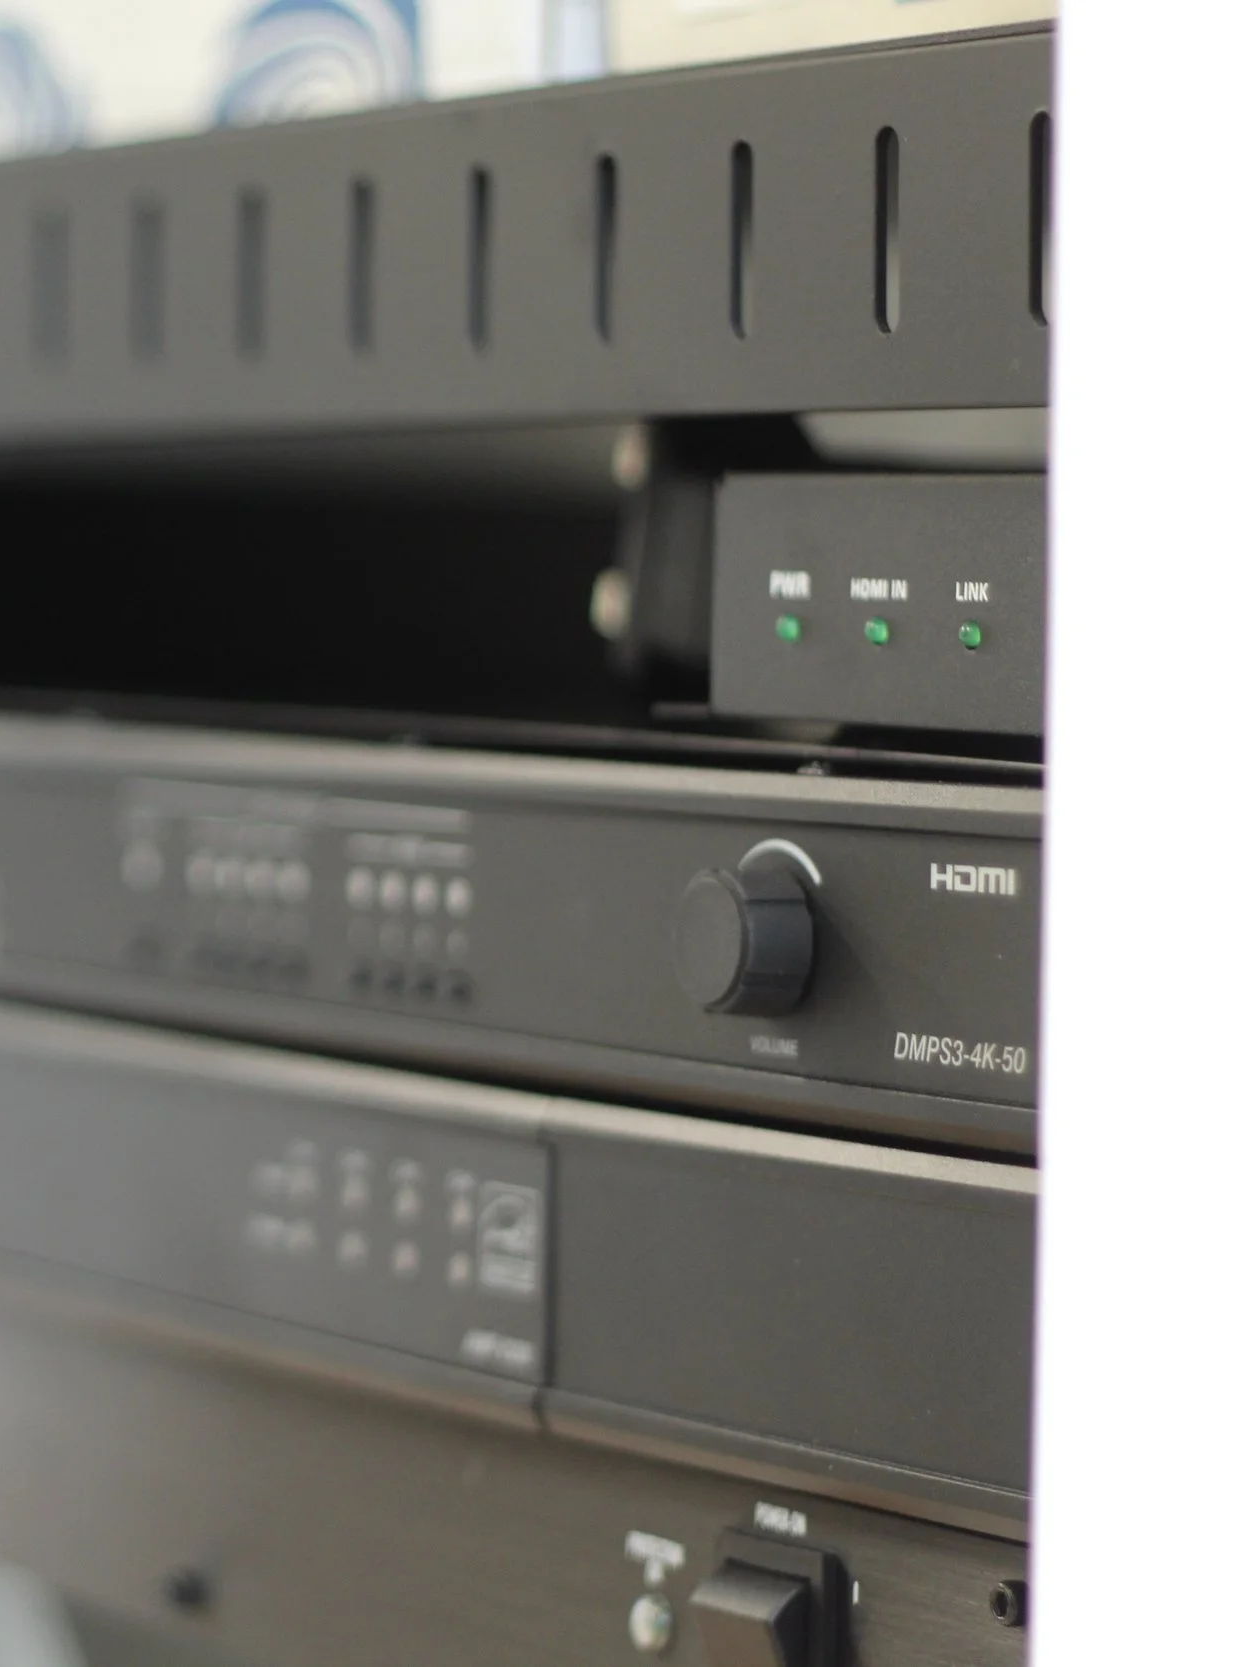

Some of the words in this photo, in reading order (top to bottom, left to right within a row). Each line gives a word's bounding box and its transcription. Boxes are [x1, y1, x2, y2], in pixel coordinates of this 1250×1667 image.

[769, 569, 811, 599] PWR
[850, 578, 889, 600] HDMI
[891, 578, 908, 600] IN
[956, 581, 989, 602] LINK
[930, 862, 1016, 896] HDMI
[893, 1031, 1026, 1074] DMPS3-4K-50
